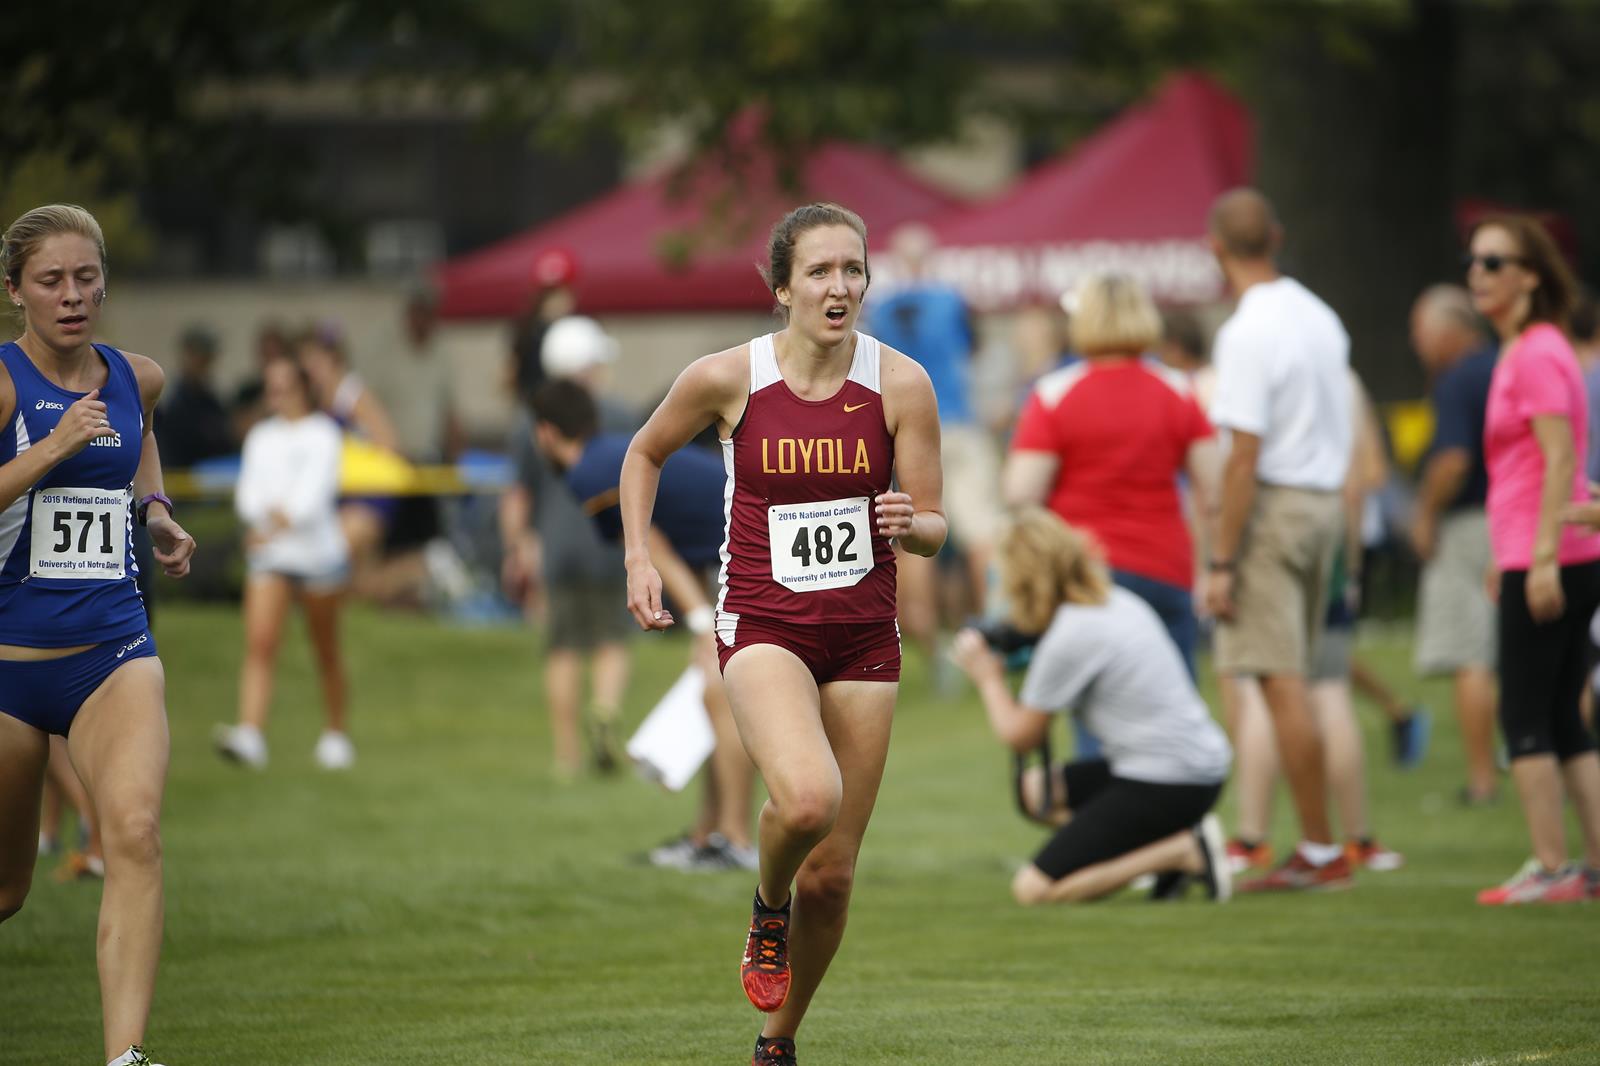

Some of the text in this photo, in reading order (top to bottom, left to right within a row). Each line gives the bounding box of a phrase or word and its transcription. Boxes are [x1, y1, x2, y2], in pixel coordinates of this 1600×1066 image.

[45, 402, 64, 410] asics
[90, 432, 121, 447] OUIS
[762, 438, 871, 474] LOYOLA
[42, 495, 122, 505] 2016 National Catholic
[778, 504, 862, 521] 2016 National Catholic
[53, 511, 113, 554] 571
[791, 521, 858, 567] 482
[39, 560, 119, 569] University of Notre Dame
[781, 567, 868, 583] University of Notre Dame
[127, 633, 147, 650] asics
